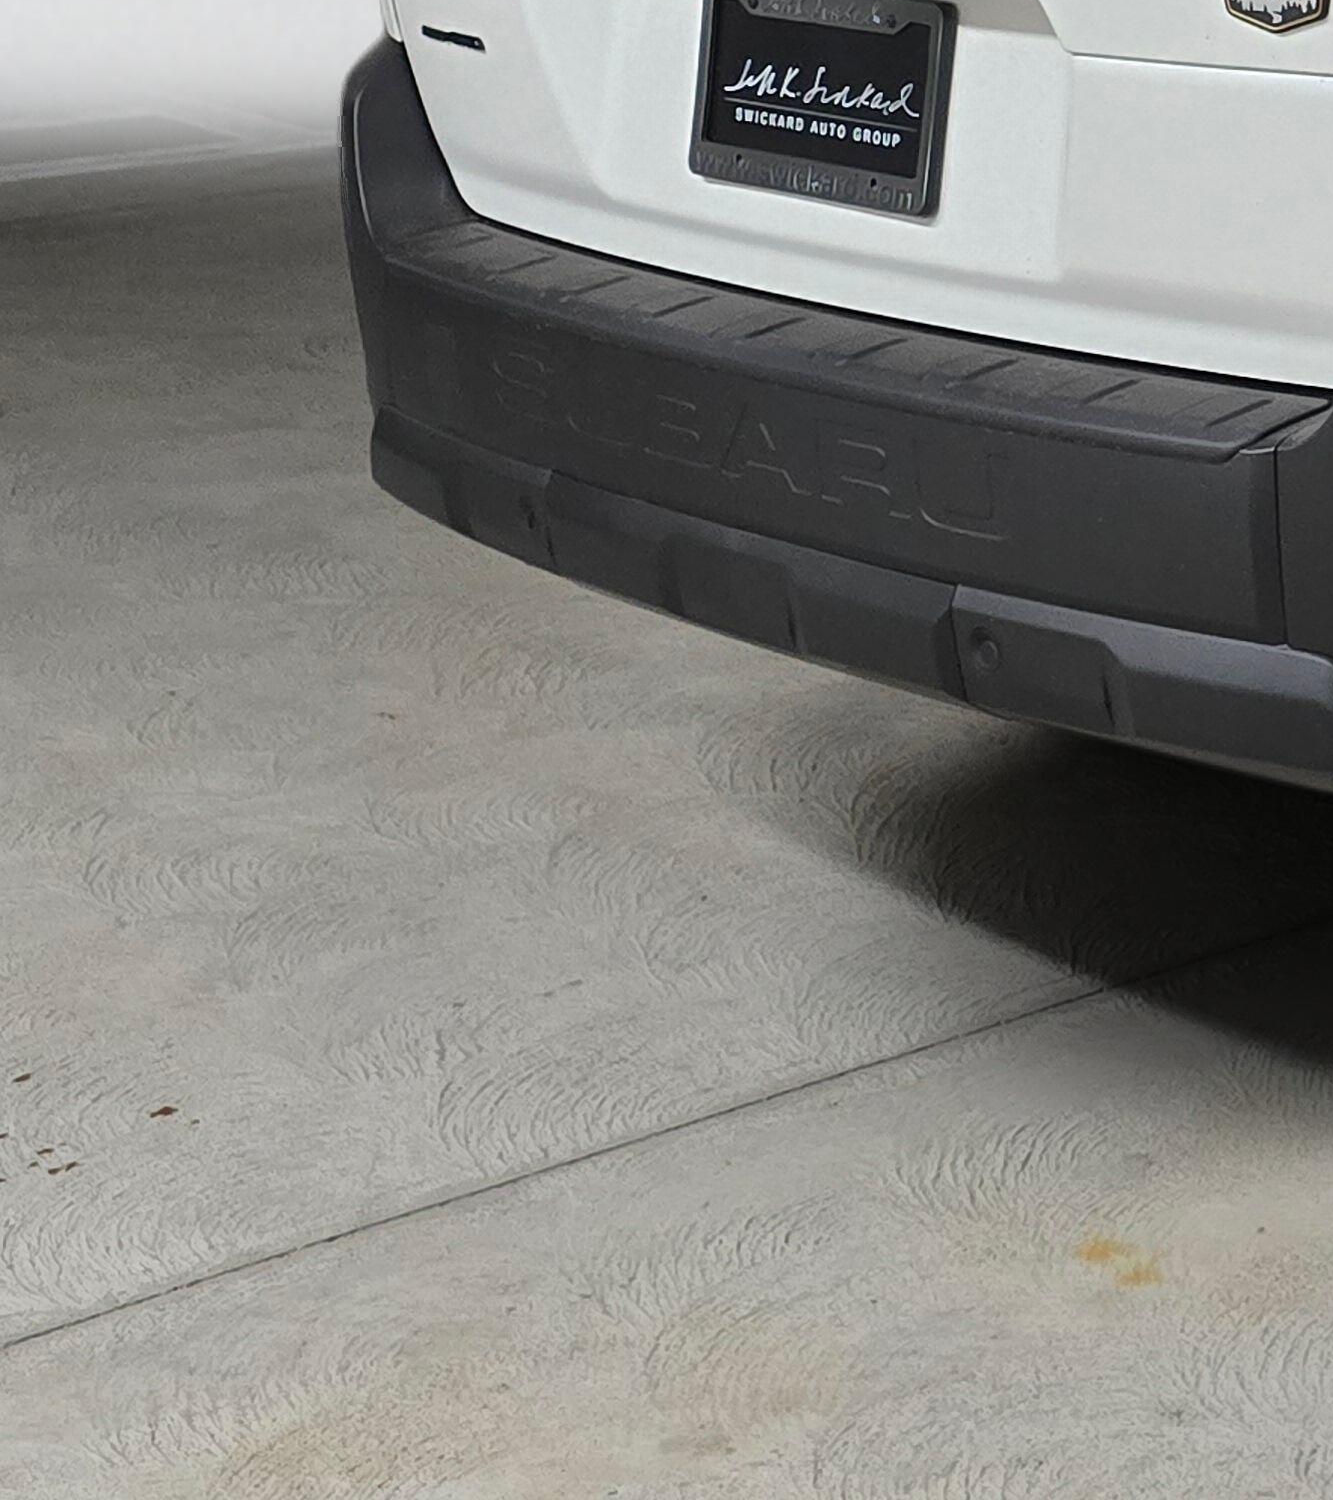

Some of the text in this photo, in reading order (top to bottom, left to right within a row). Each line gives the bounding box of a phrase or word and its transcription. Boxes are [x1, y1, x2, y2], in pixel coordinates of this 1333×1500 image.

[735, 106, 901, 148] SWICKARD AUTO GROUP
